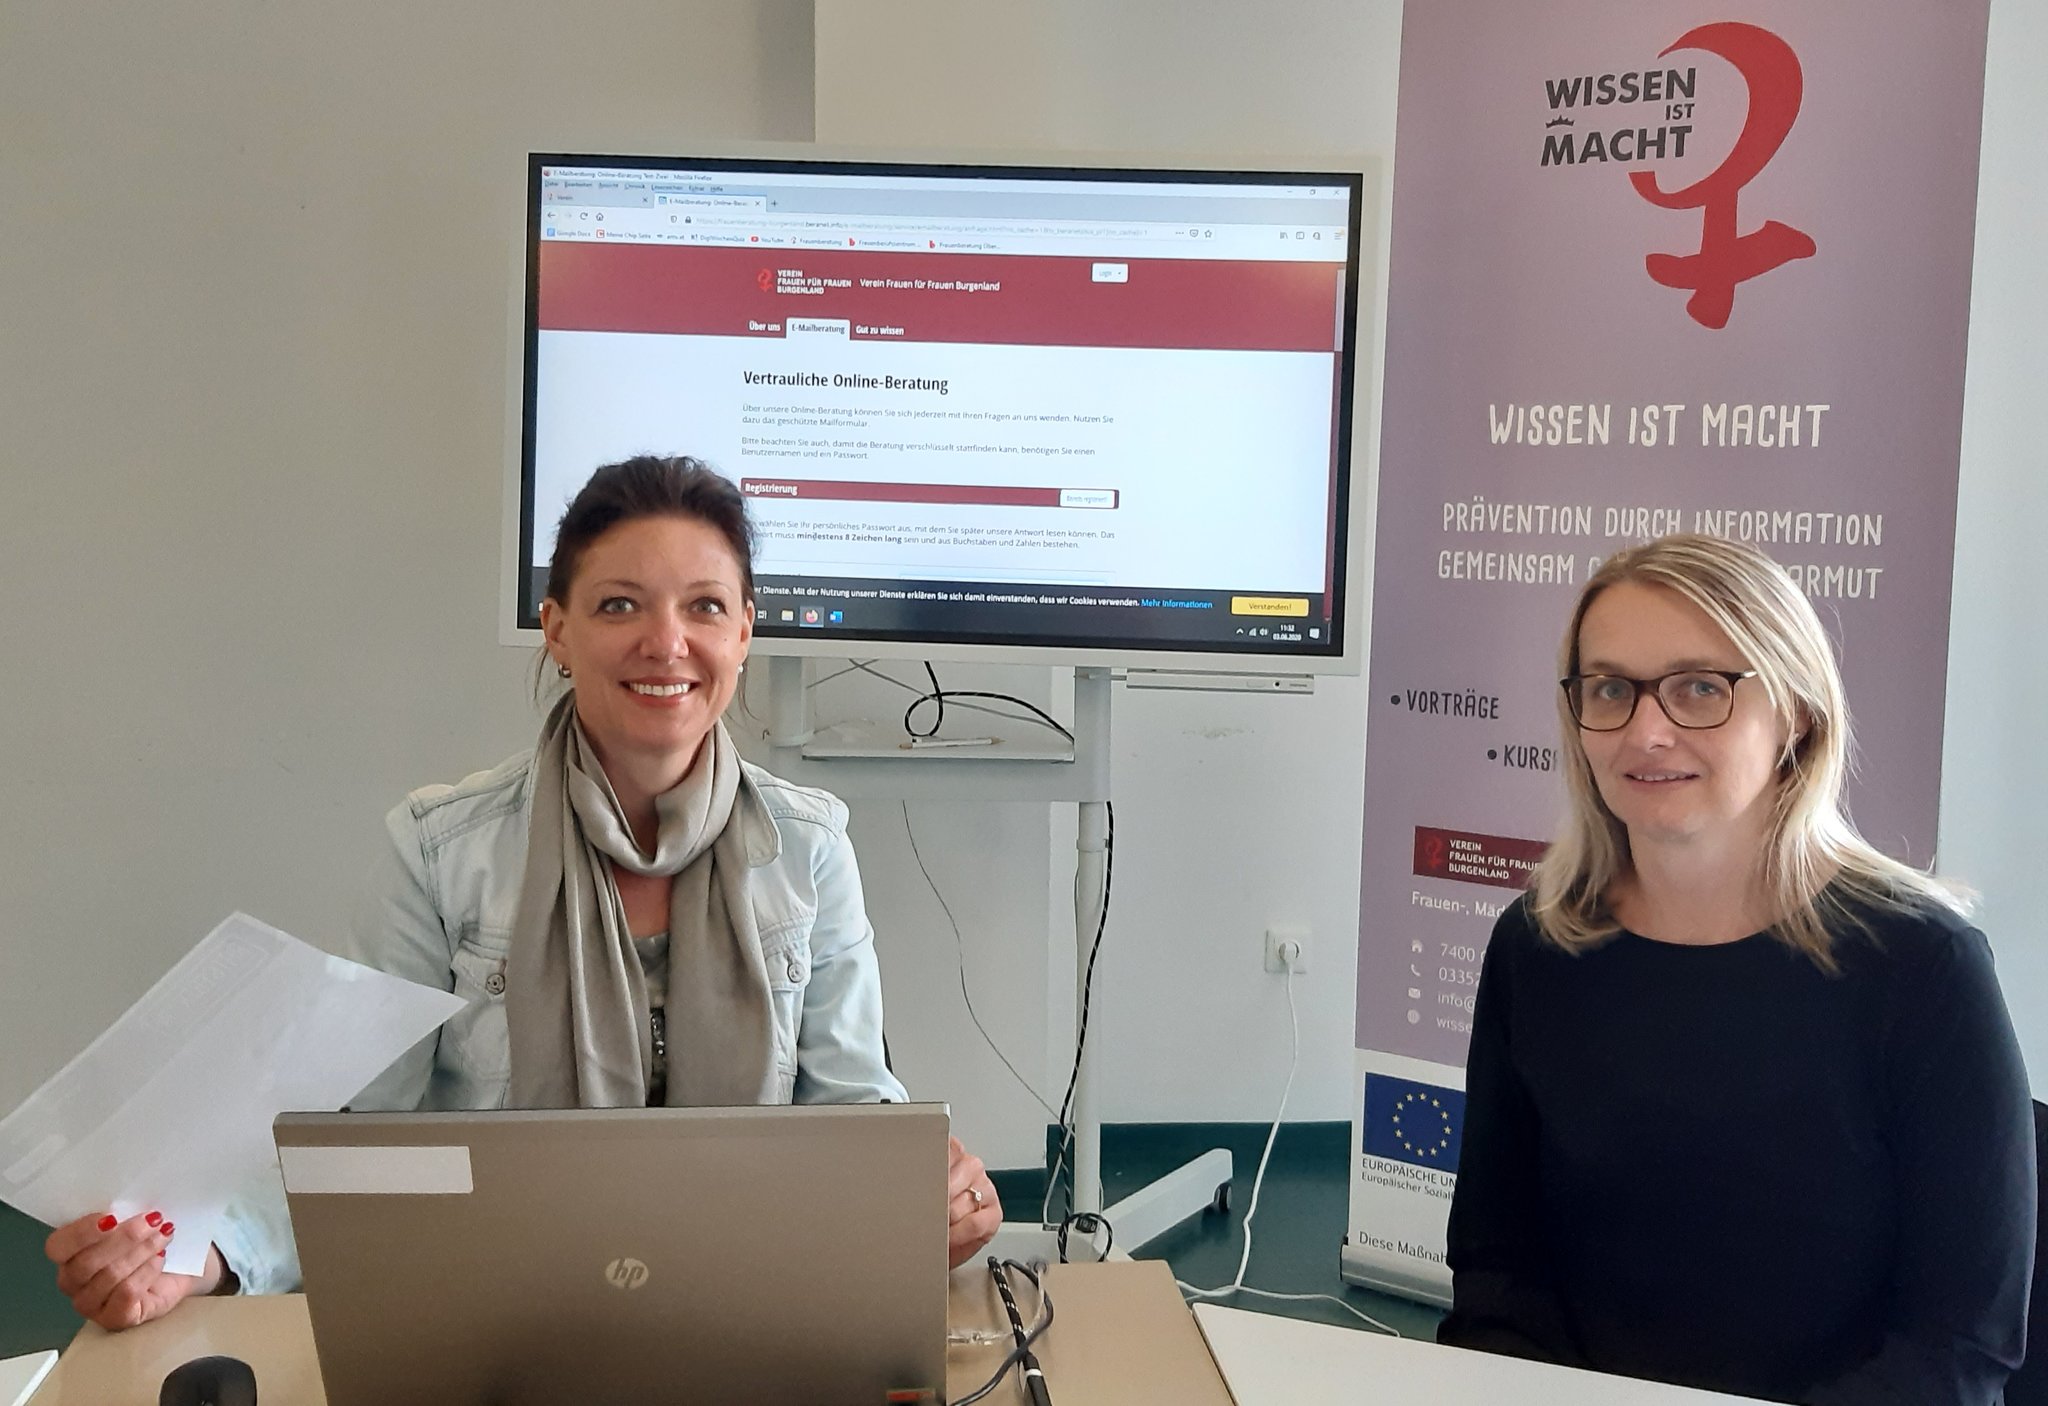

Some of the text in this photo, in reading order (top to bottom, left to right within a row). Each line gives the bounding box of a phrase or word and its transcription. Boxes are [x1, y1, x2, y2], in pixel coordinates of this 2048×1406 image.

[1545, 68, 1696, 110] WISSEN
[1665, 103, 1695, 121] IST
[1540, 125, 1693, 167] MACHT
[777, 269, 803, 277] VEREIN
[777, 278, 852, 288] FRAUEN FÜR FRAUEN
[777, 287, 825, 295] BURGENLAND
[860, 278, 1000, 292] Verein Frauen für Frauen Burgenland
[749, 320, 781, 331] Über uns
[791, 323, 845, 334] E-Mailberatung
[856, 325, 904, 336] Gut zu wissen
[743, 370, 949, 396] Vertrauliche Online-Beratung
[742, 404, 761, 413] Über
[763, 406, 789, 414] unsere
[791, 405, 853, 417] Online-Beratung
[855, 407, 883, 417] können
[884, 409, 896, 417] Sie
[898, 409, 913, 417] sich
[913, 409, 946, 420] jederzeit
[948, 411, 961, 419] mit
[962, 411, 983, 420] Ihren
[984, 412, 1010, 421] Fragen
[1073, 414, 1101, 423] Nutzen
[1102, 415, 1114, 423] Sie
[742, 416, 761, 424] dazu
[762, 416, 776, 424] das
[777, 417, 818, 427] geschützte
[1489, 403, 1831, 448] WISSEN IST MACHT
[741, 437, 1095, 456] Bitte beachten Sie auch, damit die Beratung verschlüsselt stattfinden kann, benötigen Sie einen
[741, 448, 801, 457] Benutzernamen
[803, 450, 818, 458] und
[819, 450, 832, 458] ein
[745, 483, 798, 496] Registrierung
[759, 520, 785, 528] wählen
[800, 521, 810, 529] Ihr
[813, 522, 860, 532] persönliches
[862, 523, 896, 532] Passwort
[914, 525, 927, 533] mit
[929, 526, 946, 534] dem
[948, 526, 959, 534] Sie
[960, 527, 984, 537] später
[986, 528, 1013, 536] unsere
[1014, 528, 1044, 537] Antwort
[1046, 529, 1066, 538] lesen
[1101, 531, 1115, 539] Das
[1443, 495, 1883, 546] PRÄVENTION DURCH INFORMATION
[797, 532, 843, 541] mindestens
[845, 533, 850, 541] 8
[852, 533, 883, 542] Zeichen
[885, 535, 902, 544] lang
[904, 535, 919, 543] sein
[921, 536, 936, 544] und
[938, 537, 951, 545] aus
[953, 537, 997, 546] Buchstaben
[999, 538, 1013, 546] und
[1015, 539, 1041, 548] Zahlen
[1438, 550, 1575, 585] GEMEINSAM
[763, 586, 792, 595] Dienste.
[793, 587, 805, 595] Mit
[807, 587, 819, 596] der
[820, 588, 850, 598] Nutzung
[851, 590, 877, 598] unserer
[879, 590, 905, 599] Dienste
[907, 591, 936, 600] erklären
[937, 592, 948, 600] Sie
[949, 592, 963, 601] sich
[965, 592, 985, 601] damit
[987, 594, 1038, 604] einverstanden,
[1040, 595, 1055, 604] dass
[1056, 596, 1068, 604] wir
[1069, 596, 1097, 605] Cookies
[1098, 597, 1140, 607] verwenden.
[1141, 599, 1160, 607] Mehr
[1162, 599, 1213, 609] Informationen
[1248, 602, 1292, 611] Verstanden!
[1406, 688, 1499, 719] VORTRÄGE
[1450, 839, 1482, 851] VEREIN
[1449, 852, 1485, 864] FRAUEN
[1487, 855, 1506, 868] FÜR
[1448, 863, 1509, 880] BURGENLAND
[1411, 891, 1506, 918] Frauen-, Mäd
[1440, 943, 1475, 962] 7400
[1438, 967, 1481, 987] 03352
[1438, 992, 1477, 1013] info@
[1361, 1172, 1422, 1193] Europäischer
[1440, 1175, 1457, 1189] UN
[1359, 1231, 1448, 1265] Diese Maßnah
[612, 1257, 645, 1288] hp
